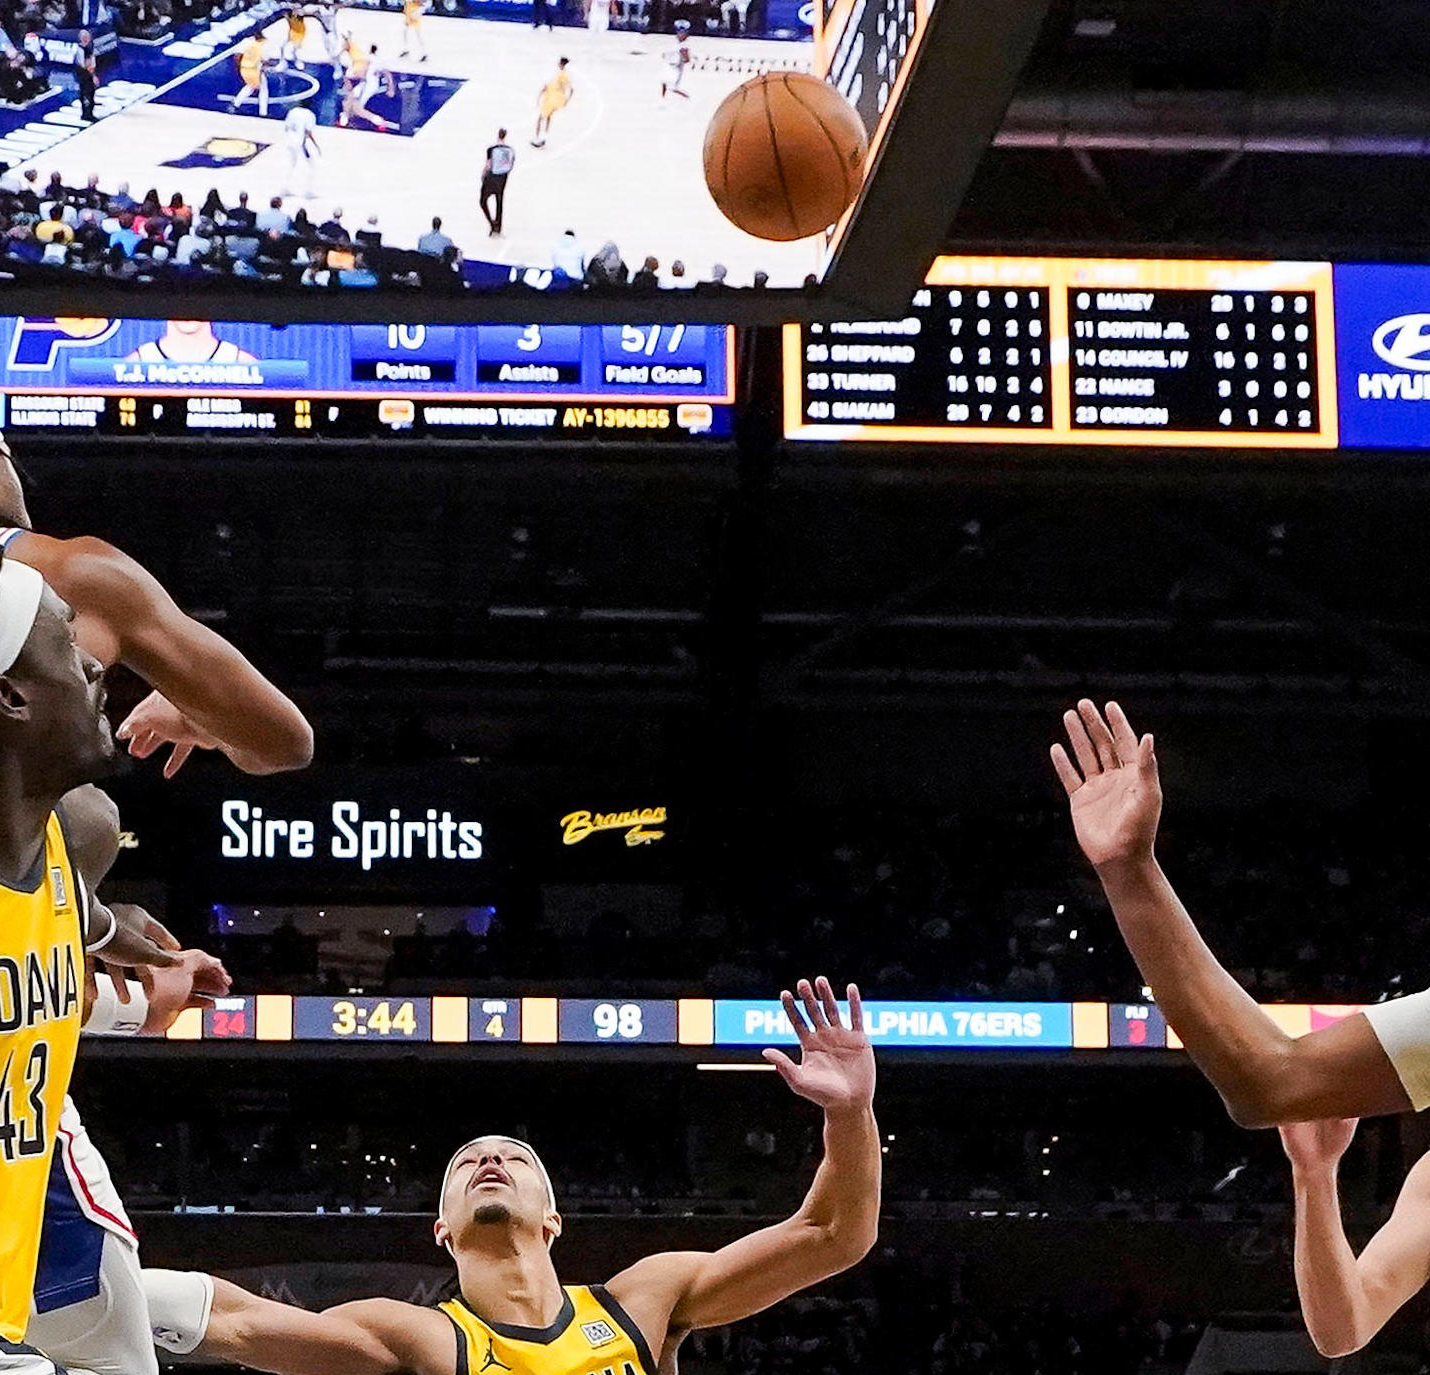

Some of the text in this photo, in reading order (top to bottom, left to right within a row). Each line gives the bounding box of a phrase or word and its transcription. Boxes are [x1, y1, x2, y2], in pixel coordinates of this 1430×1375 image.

[376, 363, 431, 380] Points
[499, 365, 559, 382] Assists
[606, 366, 702, 384] Field Goals
[424, 407, 498, 425] WINNING
[499, 409, 557, 426] TICKET
[222, 799, 484, 870] Sire Spirits
[211, 1011, 246, 1036] 24
[331, 1000, 418, 1037] 3:44
[485, 1014, 505, 1038] 4
[592, 1003, 643, 1038] 98
[952, 1011, 1043, 1038] 76ERS
[1127, 1020, 1147, 1045] 3
